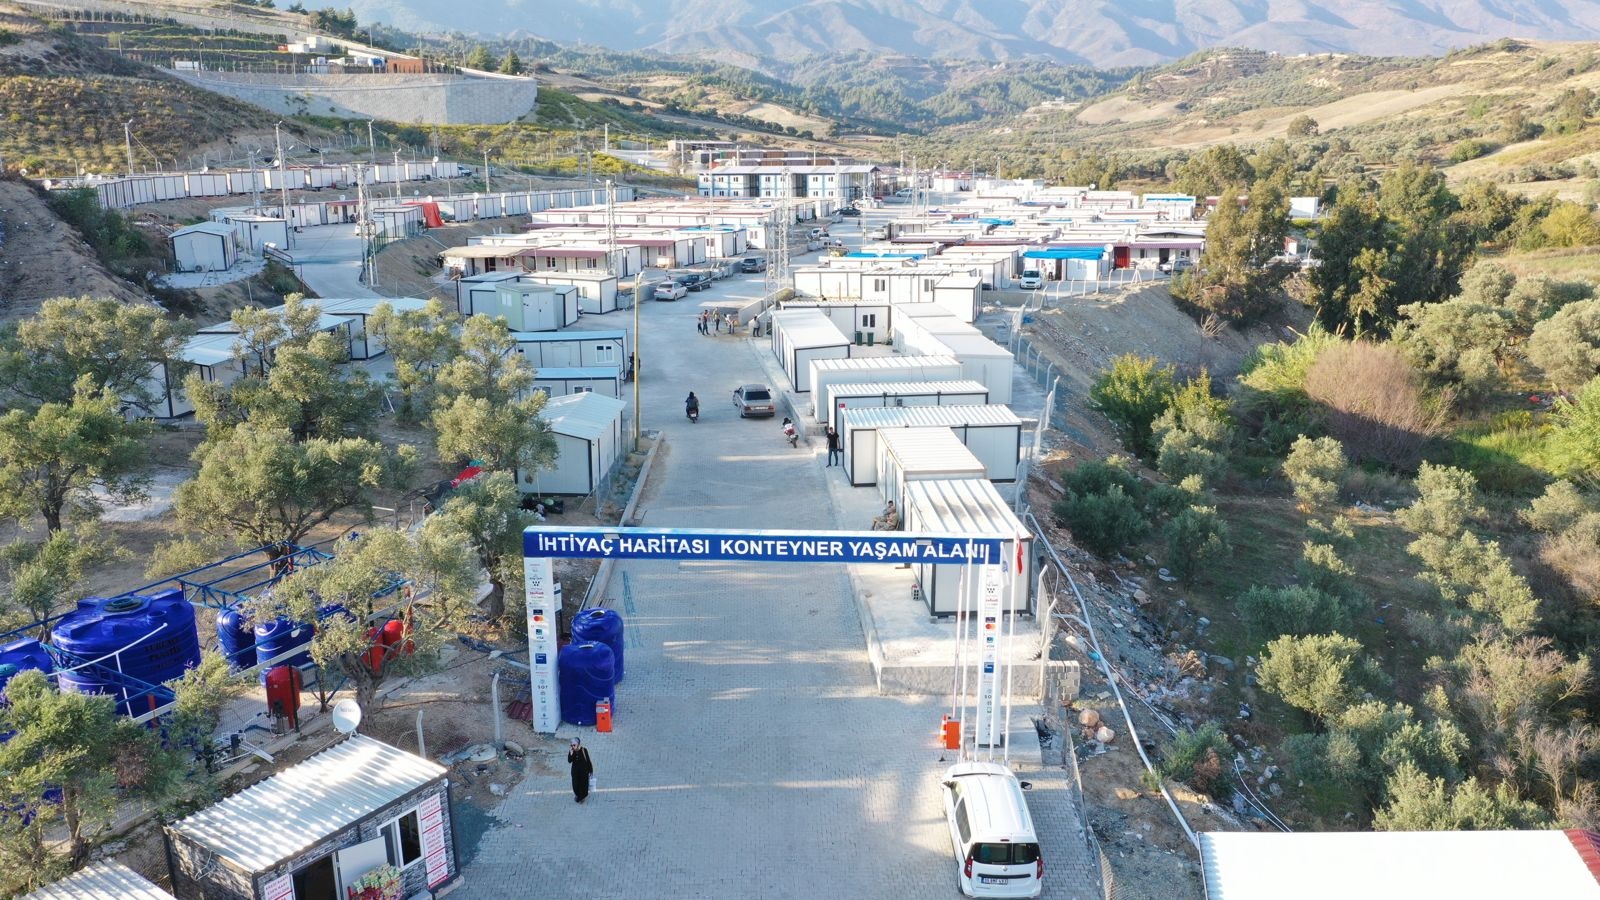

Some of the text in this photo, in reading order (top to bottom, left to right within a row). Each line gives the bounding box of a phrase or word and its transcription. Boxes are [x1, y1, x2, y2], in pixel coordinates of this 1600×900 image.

[538, 533, 985, 560] İHTİYAÇ HARİTASI KONTEYNER YAŞAM ALANI
